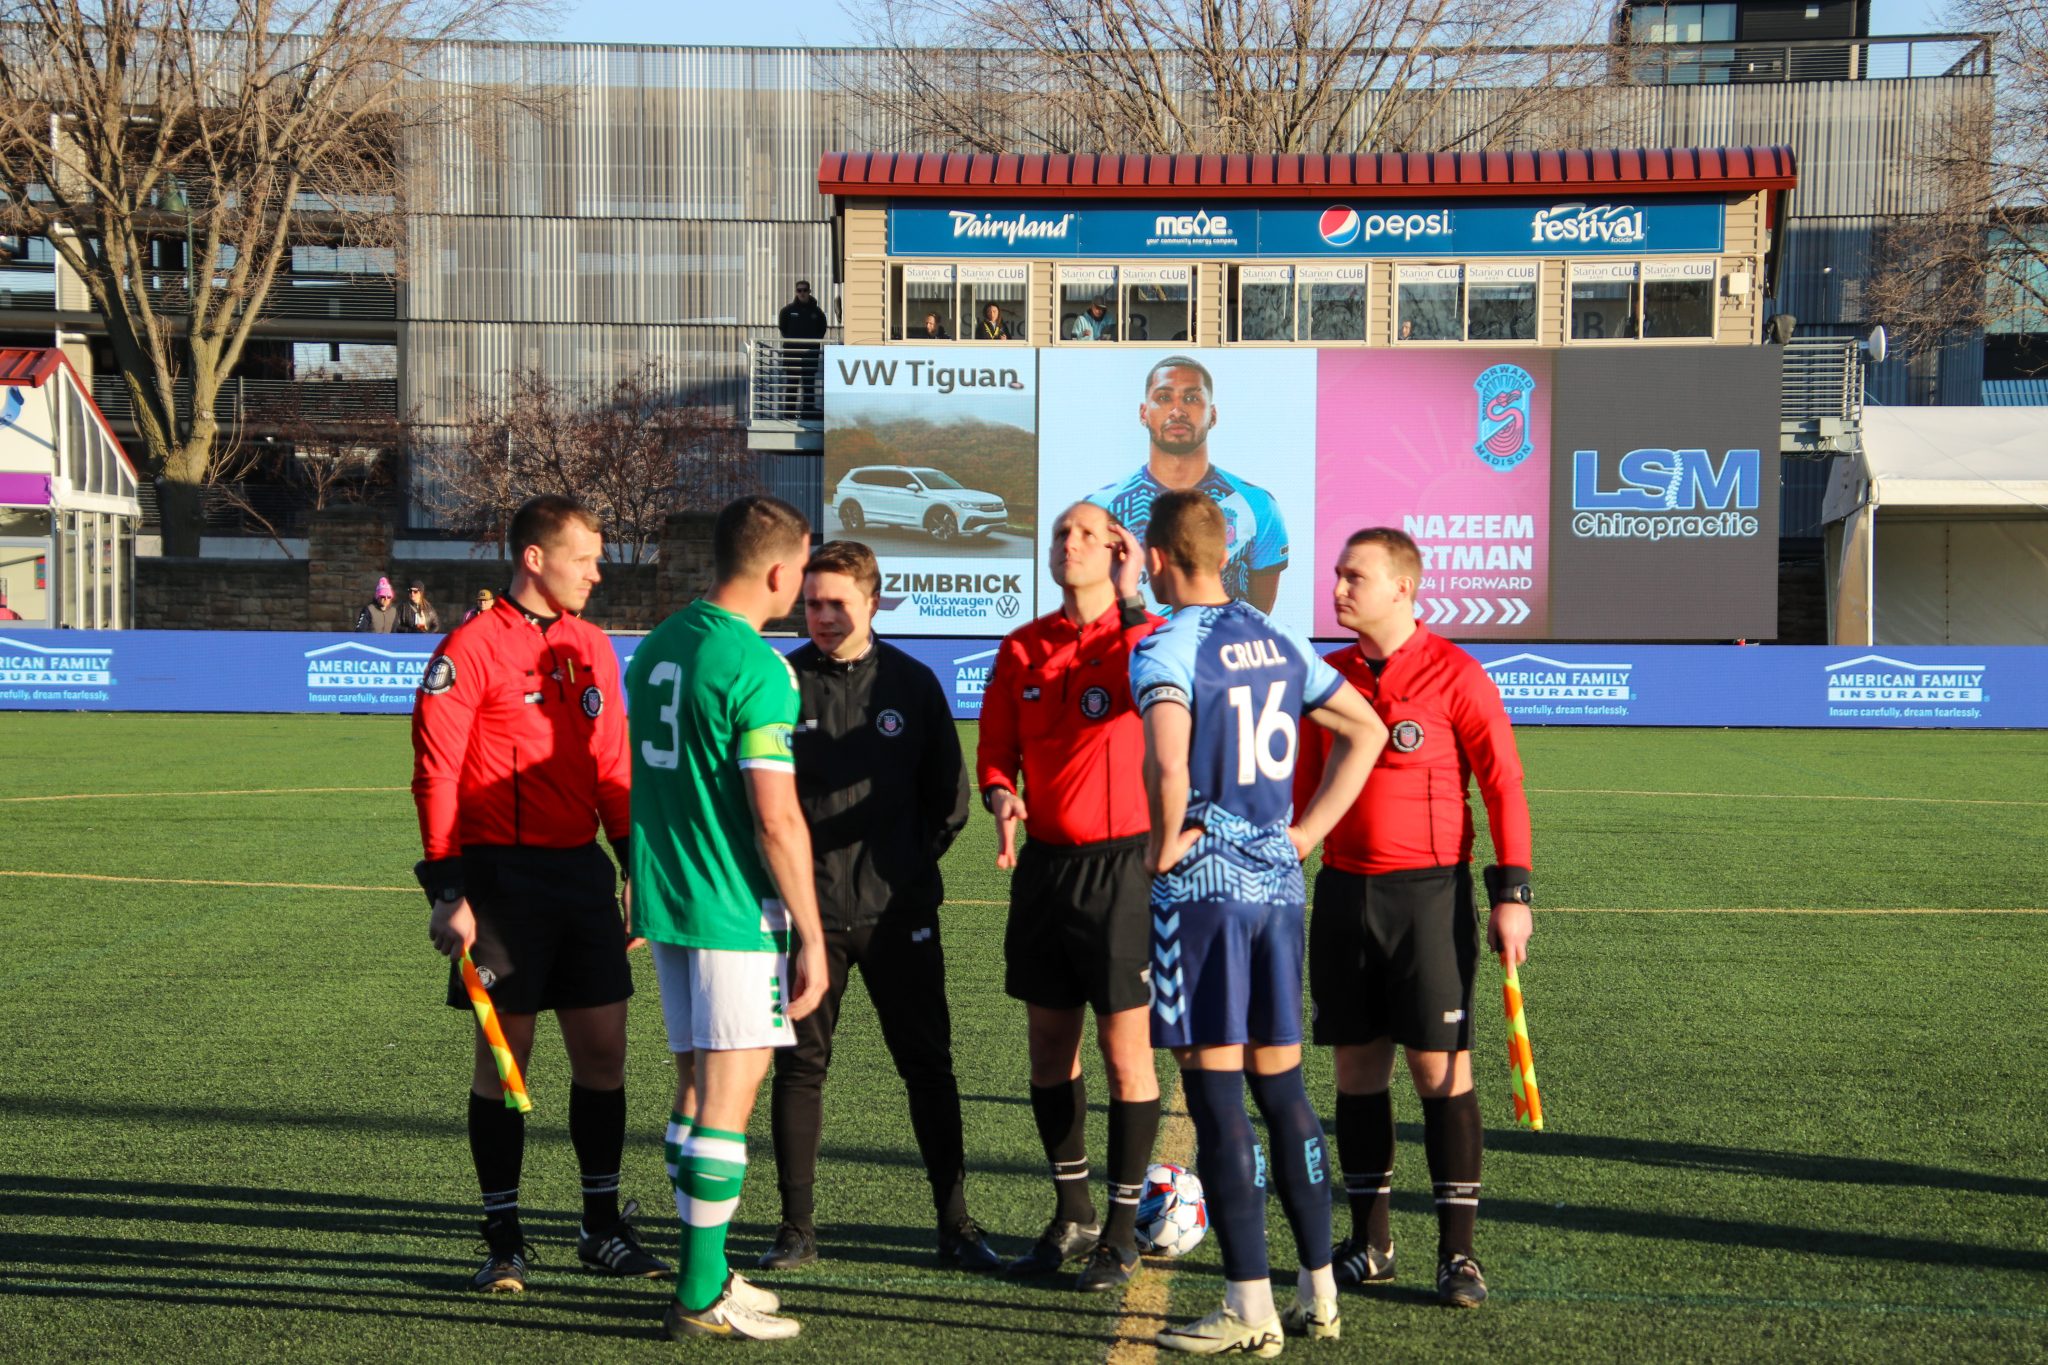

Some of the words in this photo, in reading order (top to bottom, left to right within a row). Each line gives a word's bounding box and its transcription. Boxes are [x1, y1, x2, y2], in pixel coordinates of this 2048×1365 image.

[949, 210, 1070, 245] Dairyland
[1365, 209, 1448, 241] pepsi
[1531, 209, 1644, 242] festival
[1161, 237, 1191, 246] community
[1212, 238, 1237, 246] company
[997, 268, 1024, 279] CLUB
[1160, 269, 1186, 279] CLUB
[1336, 269, 1363, 279] CLUB
[1437, 269, 1464, 278] CLUB
[1507, 268, 1534, 278] CLUB
[1611, 266, 1639, 276] CLUB
[1683, 265, 1711, 275] CLUB
[837, 359, 898, 386] VW
[905, 359, 1019, 394] Tiguan
[1477, 365, 1533, 389] FORWARD
[1475, 444, 1531, 466] MADISON
[1573, 448, 1760, 511] LSM
[1403, 514, 1534, 538] NAZEEM
[1573, 512, 1758, 540] Chiropractic
[885, 573, 1022, 593] ZIMBRICK
[1450, 577, 1532, 590] FORWARD
[912, 594, 993, 608] Volkswagen
[920, 606, 987, 617] Middleton
[1220, 638, 1287, 670] CRULL
[50, 657, 110, 670] FAMILY
[308, 660, 391, 673] AMERICAN
[1488, 672, 1566, 685] AMERICAN
[1573, 673, 1629, 685] FAMILY
[1829, 674, 1915, 687] AMERICAN
[1922, 674, 1983, 687] FAMILY
[33, 690, 61, 700] dream
[309, 693, 337, 702] Insure
[380, 693, 406, 702] dream
[1840, 690, 1970, 699] INSURANCE
[641, 661, 682, 769] 3
[1556, 705, 1583, 714] dream
[1584, 705, 1629, 717] fearlessly.
[1829, 707, 1859, 717] Insure
[1904, 707, 1933, 717] dream
[1934, 707, 1982, 719] fearlessly.
[1228, 680, 1297, 786] 16
